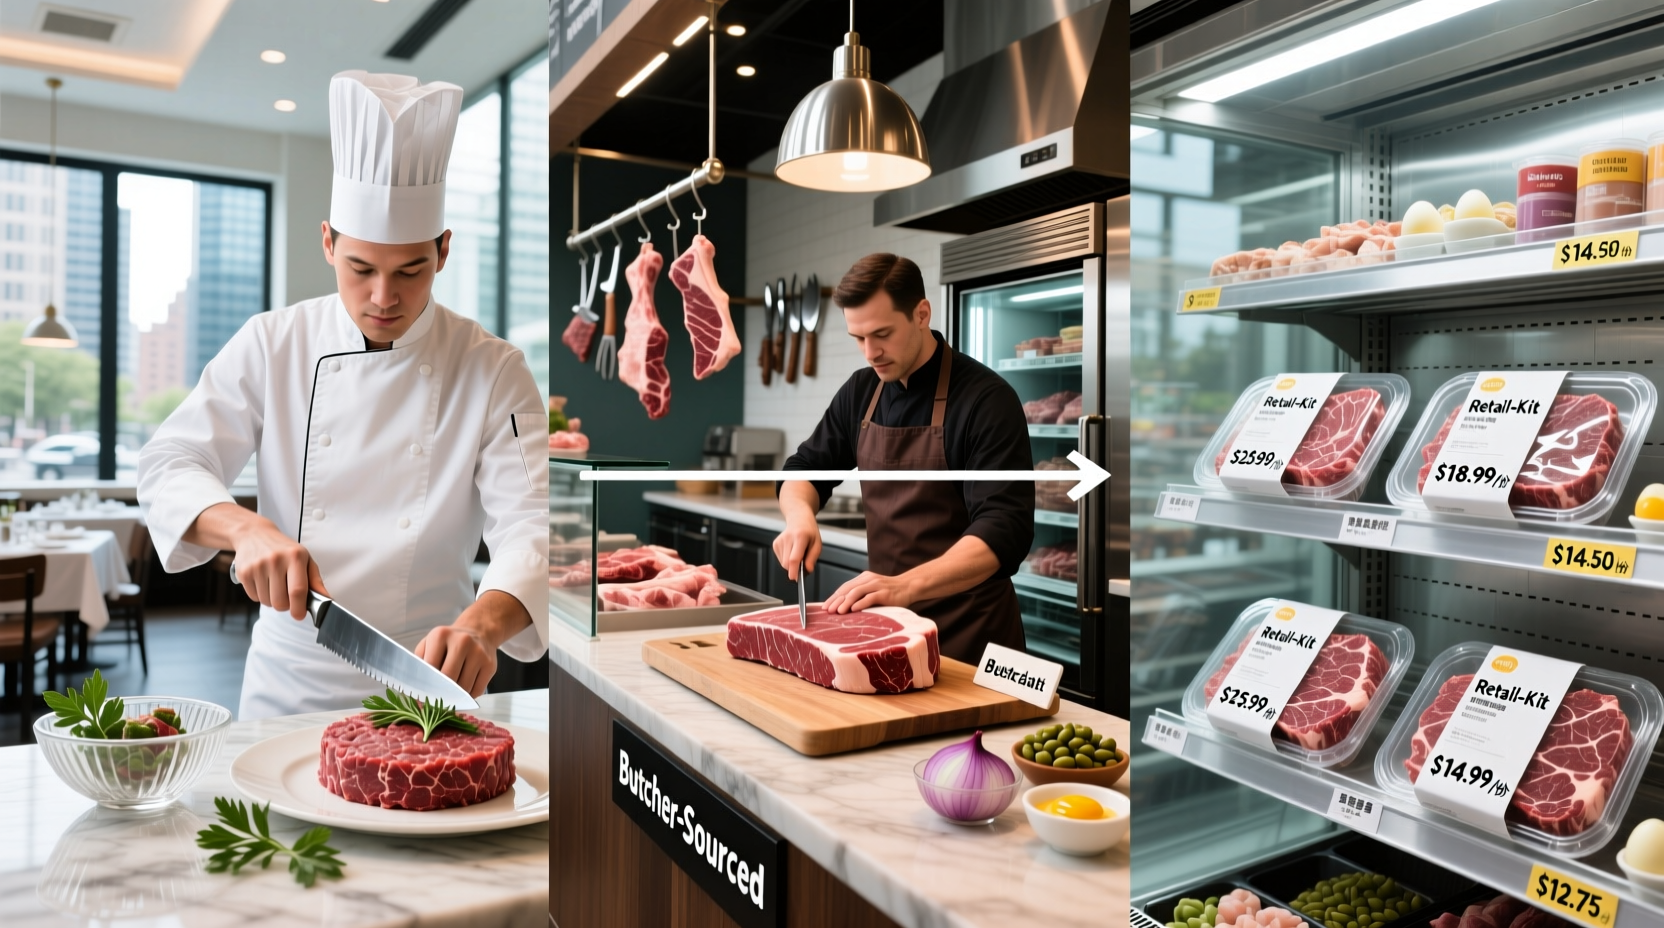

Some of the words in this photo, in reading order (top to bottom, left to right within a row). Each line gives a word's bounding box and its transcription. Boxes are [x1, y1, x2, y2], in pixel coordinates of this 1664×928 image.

[1561, 240, 1619, 264] $14.50
[1552, 543, 1614, 570] $14.50
[619, 749, 765, 910] Butcher-Sourced
[1536, 872, 1603, 917] $12.75
